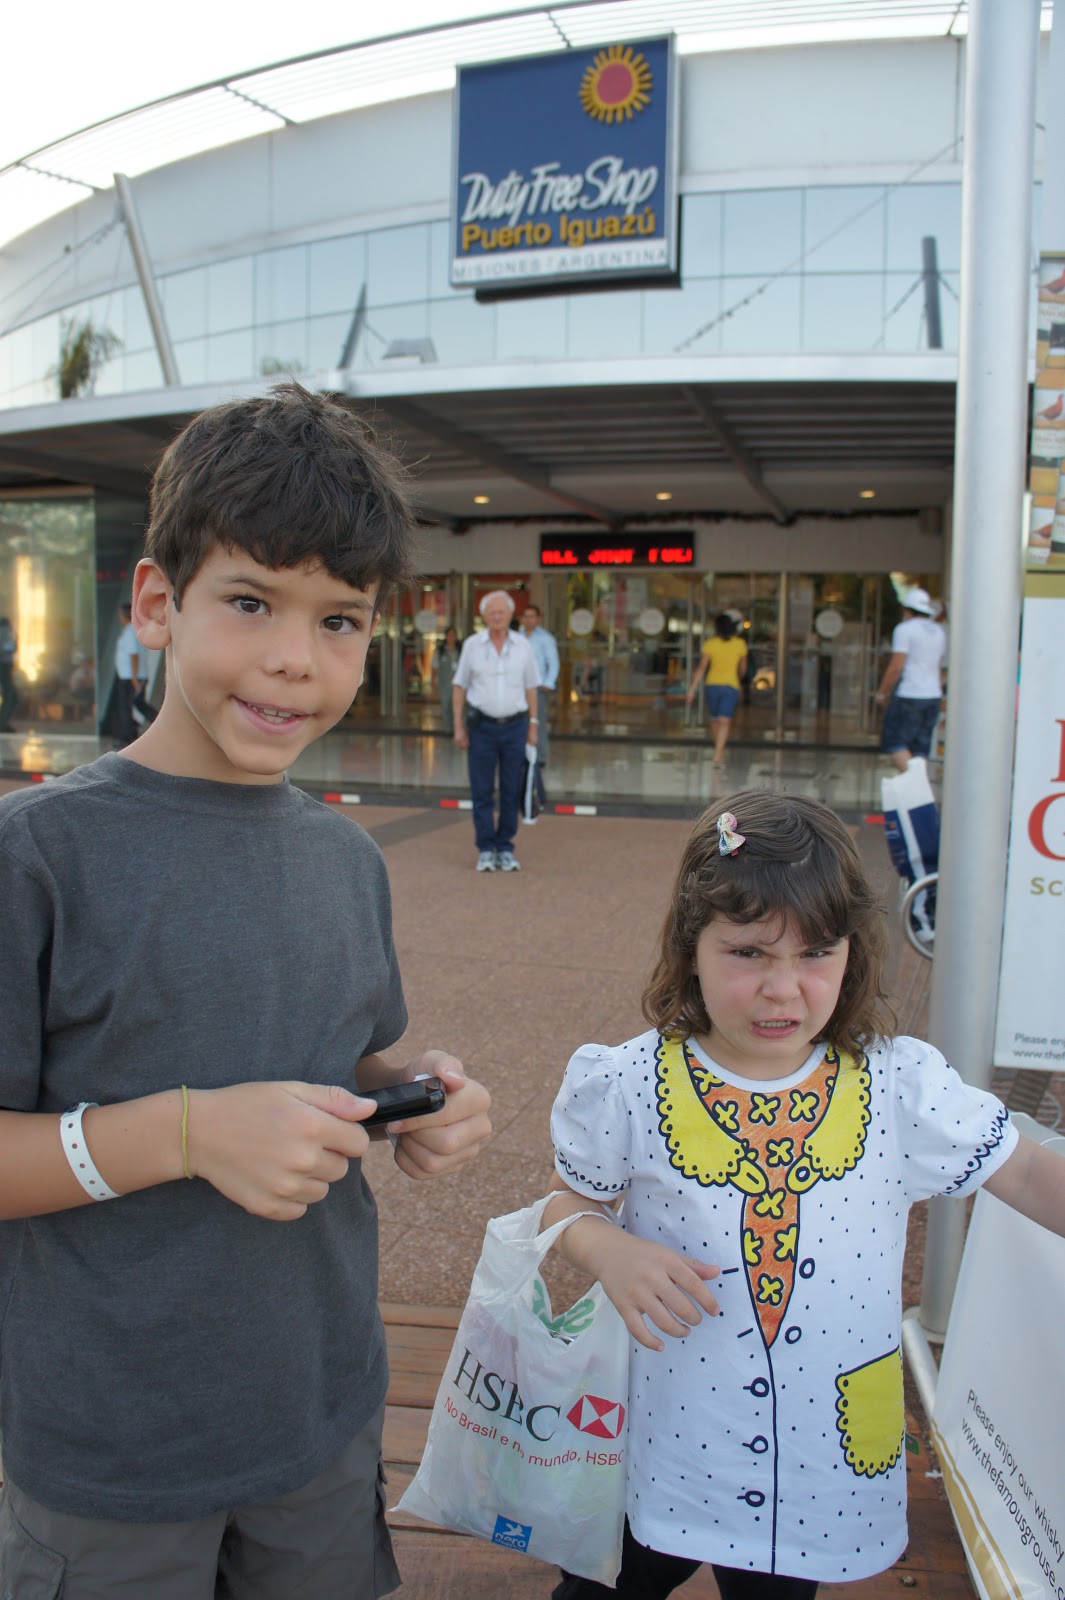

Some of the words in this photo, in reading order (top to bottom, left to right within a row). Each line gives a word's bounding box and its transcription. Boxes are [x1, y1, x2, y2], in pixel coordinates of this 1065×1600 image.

[461, 170, 530, 228] Duty
[527, 162, 584, 215] Free
[580, 156, 658, 215] Shop
[461, 220, 551, 252] Puerto
[559, 206, 656, 248] Iguazú
[559, 247, 667, 271] ARGENTINA
[1014, 1032, 1048, 1045] Please
[443, 1397, 459, 1419] No
[458, 1413, 498, 1440] Brasil
[500, 1435, 509, 1446] e
[967, 1389, 994, 1437] Please
[994, 1434, 1018, 1477] enjoy
[1018, 1473, 1034, 1501] our
[1034, 1500, 1065, 1564] whisky
[961, 1417, 1065, 1600] www.thefamousgrouse.c
